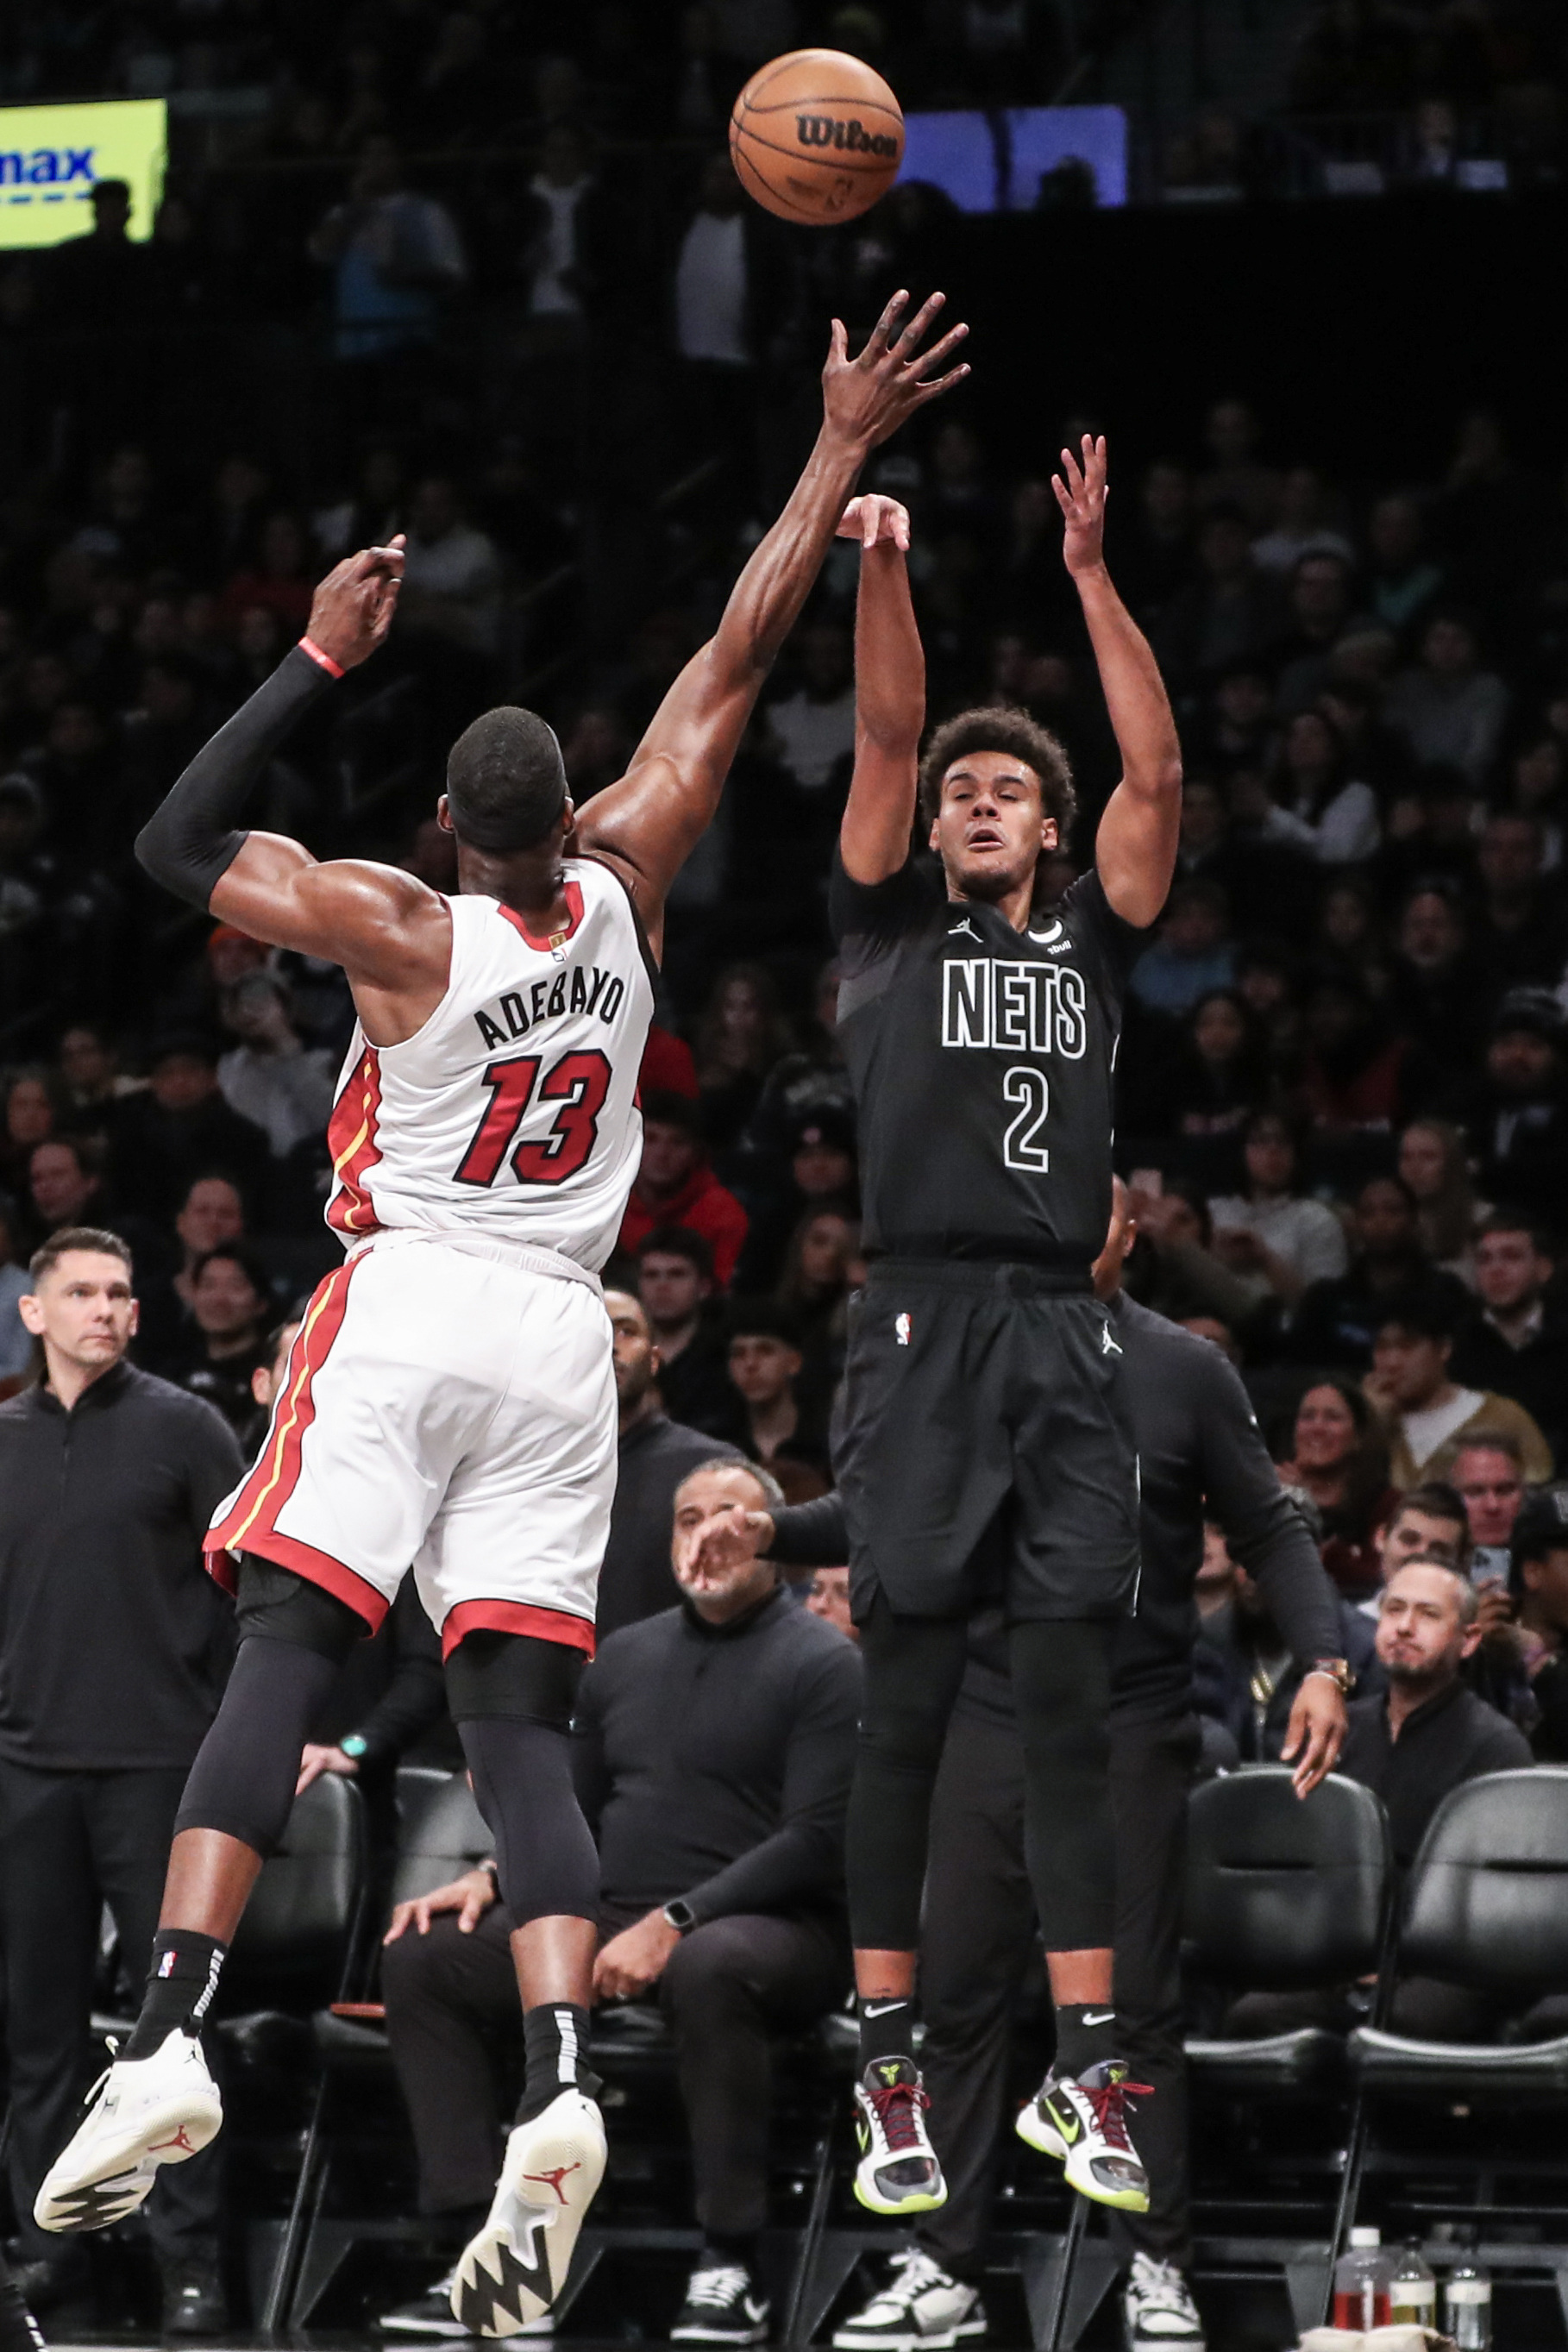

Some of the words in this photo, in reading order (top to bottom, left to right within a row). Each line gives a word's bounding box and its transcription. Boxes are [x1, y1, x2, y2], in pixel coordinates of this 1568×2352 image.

[474, 966, 624, 1051] ADEBAYO
[942, 957, 1086, 1059] NETS
[452, 1048, 613, 1188] 13
[1003, 1065, 1050, 1173] 2
